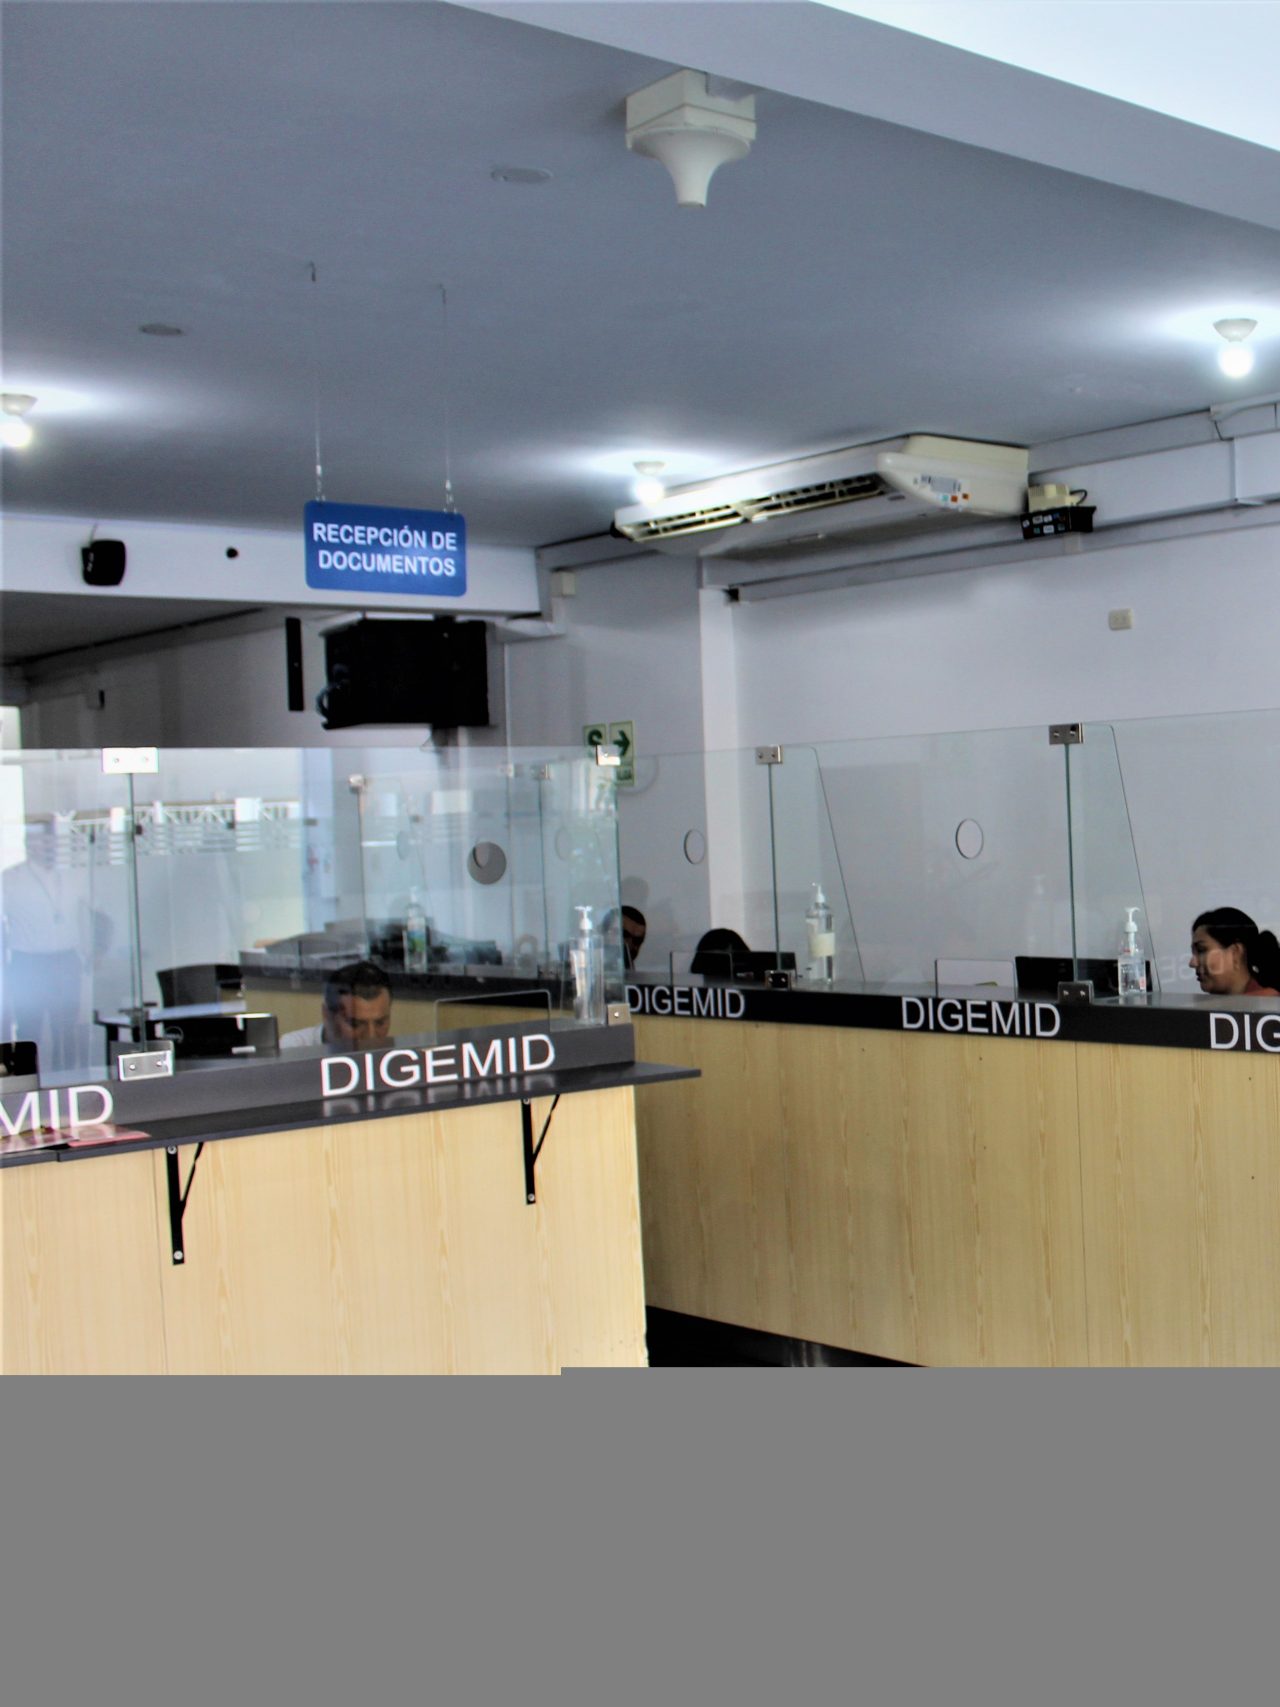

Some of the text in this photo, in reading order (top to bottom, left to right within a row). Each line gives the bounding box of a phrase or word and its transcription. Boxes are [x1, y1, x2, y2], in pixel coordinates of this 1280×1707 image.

[313, 522, 457, 551] RECEPCIÓN DE
[318, 549, 456, 577] DOCUMENTOS
[625, 984, 745, 1018] DIGEMID
[901, 997, 1061, 1037] DIGEMID
[321, 1034, 556, 1096] DIGEMID
